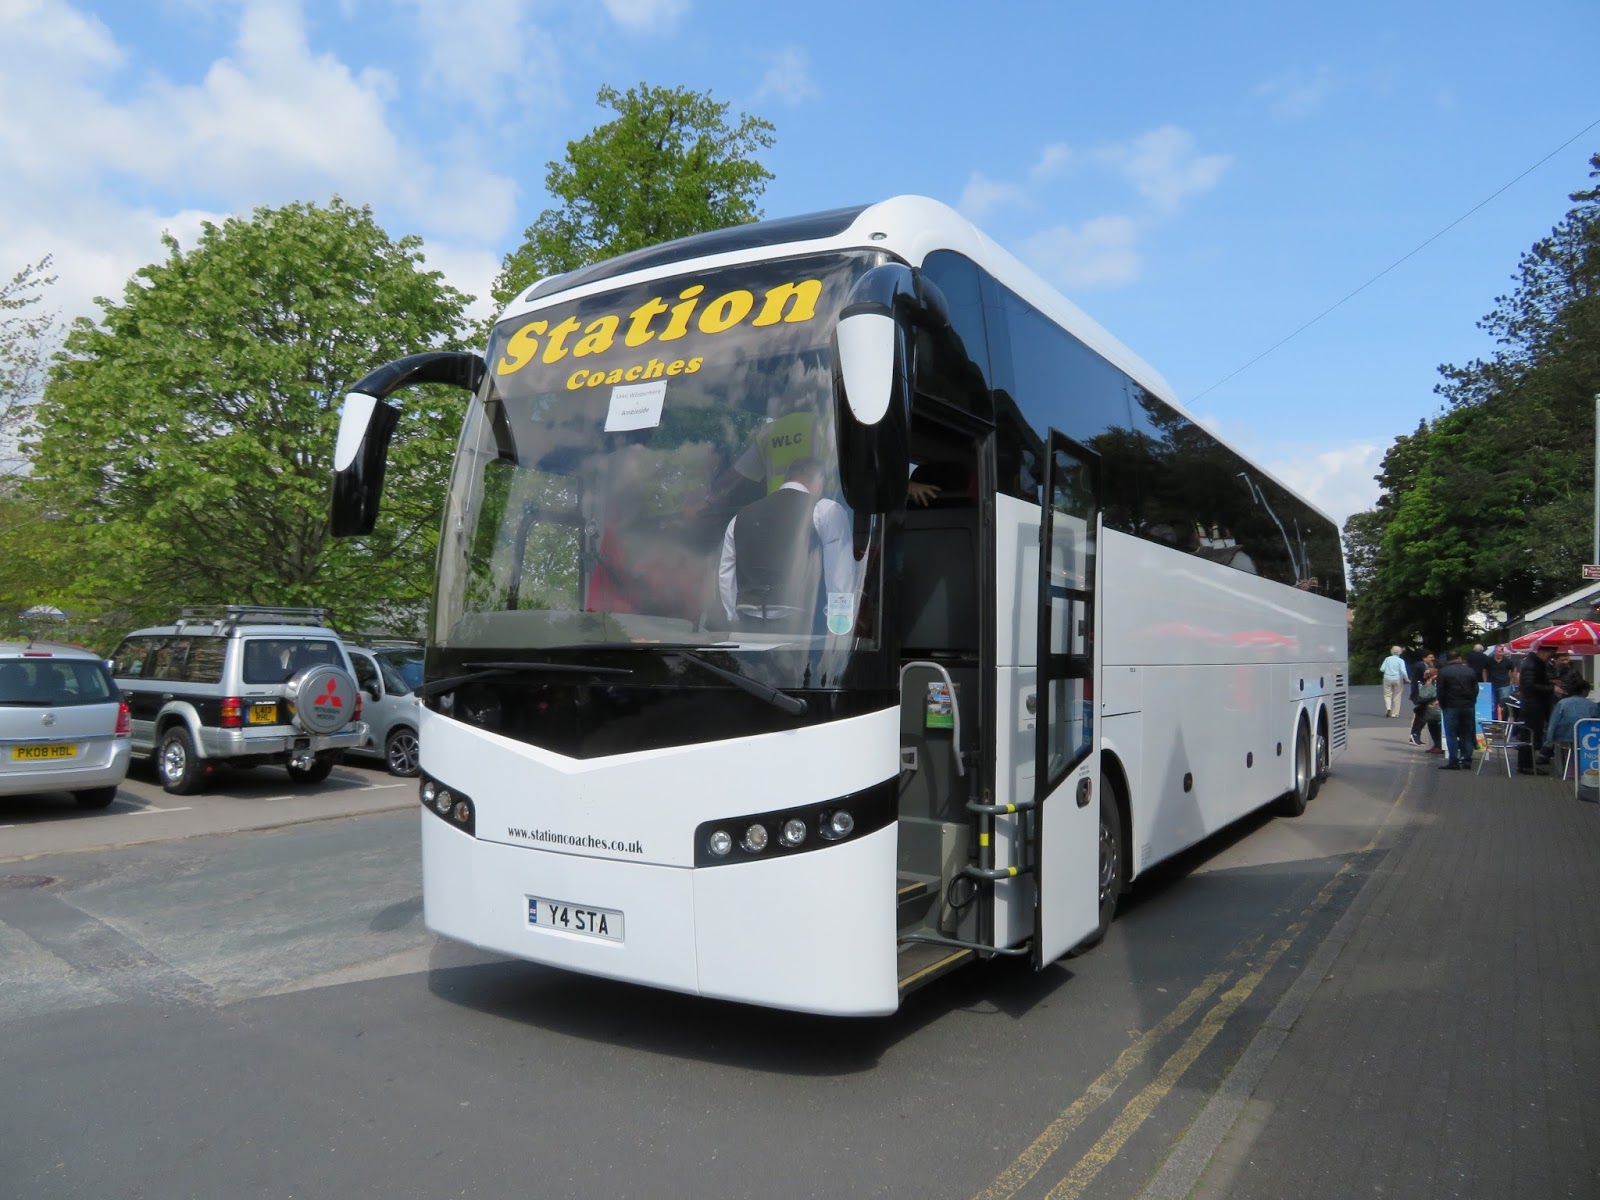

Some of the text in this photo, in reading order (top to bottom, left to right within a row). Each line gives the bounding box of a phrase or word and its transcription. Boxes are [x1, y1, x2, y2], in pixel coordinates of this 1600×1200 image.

[496, 279, 822, 376] Station
[566, 357, 703, 390] Coaches
[621, 407, 650, 416] Ambleside
[771, 432, 802, 448] WLC
[18, 746, 72, 758] PK08 HBL
[508, 827, 643, 853] www.stationcoaches.co.uk
[549, 904, 608, 934] Y4 STA
